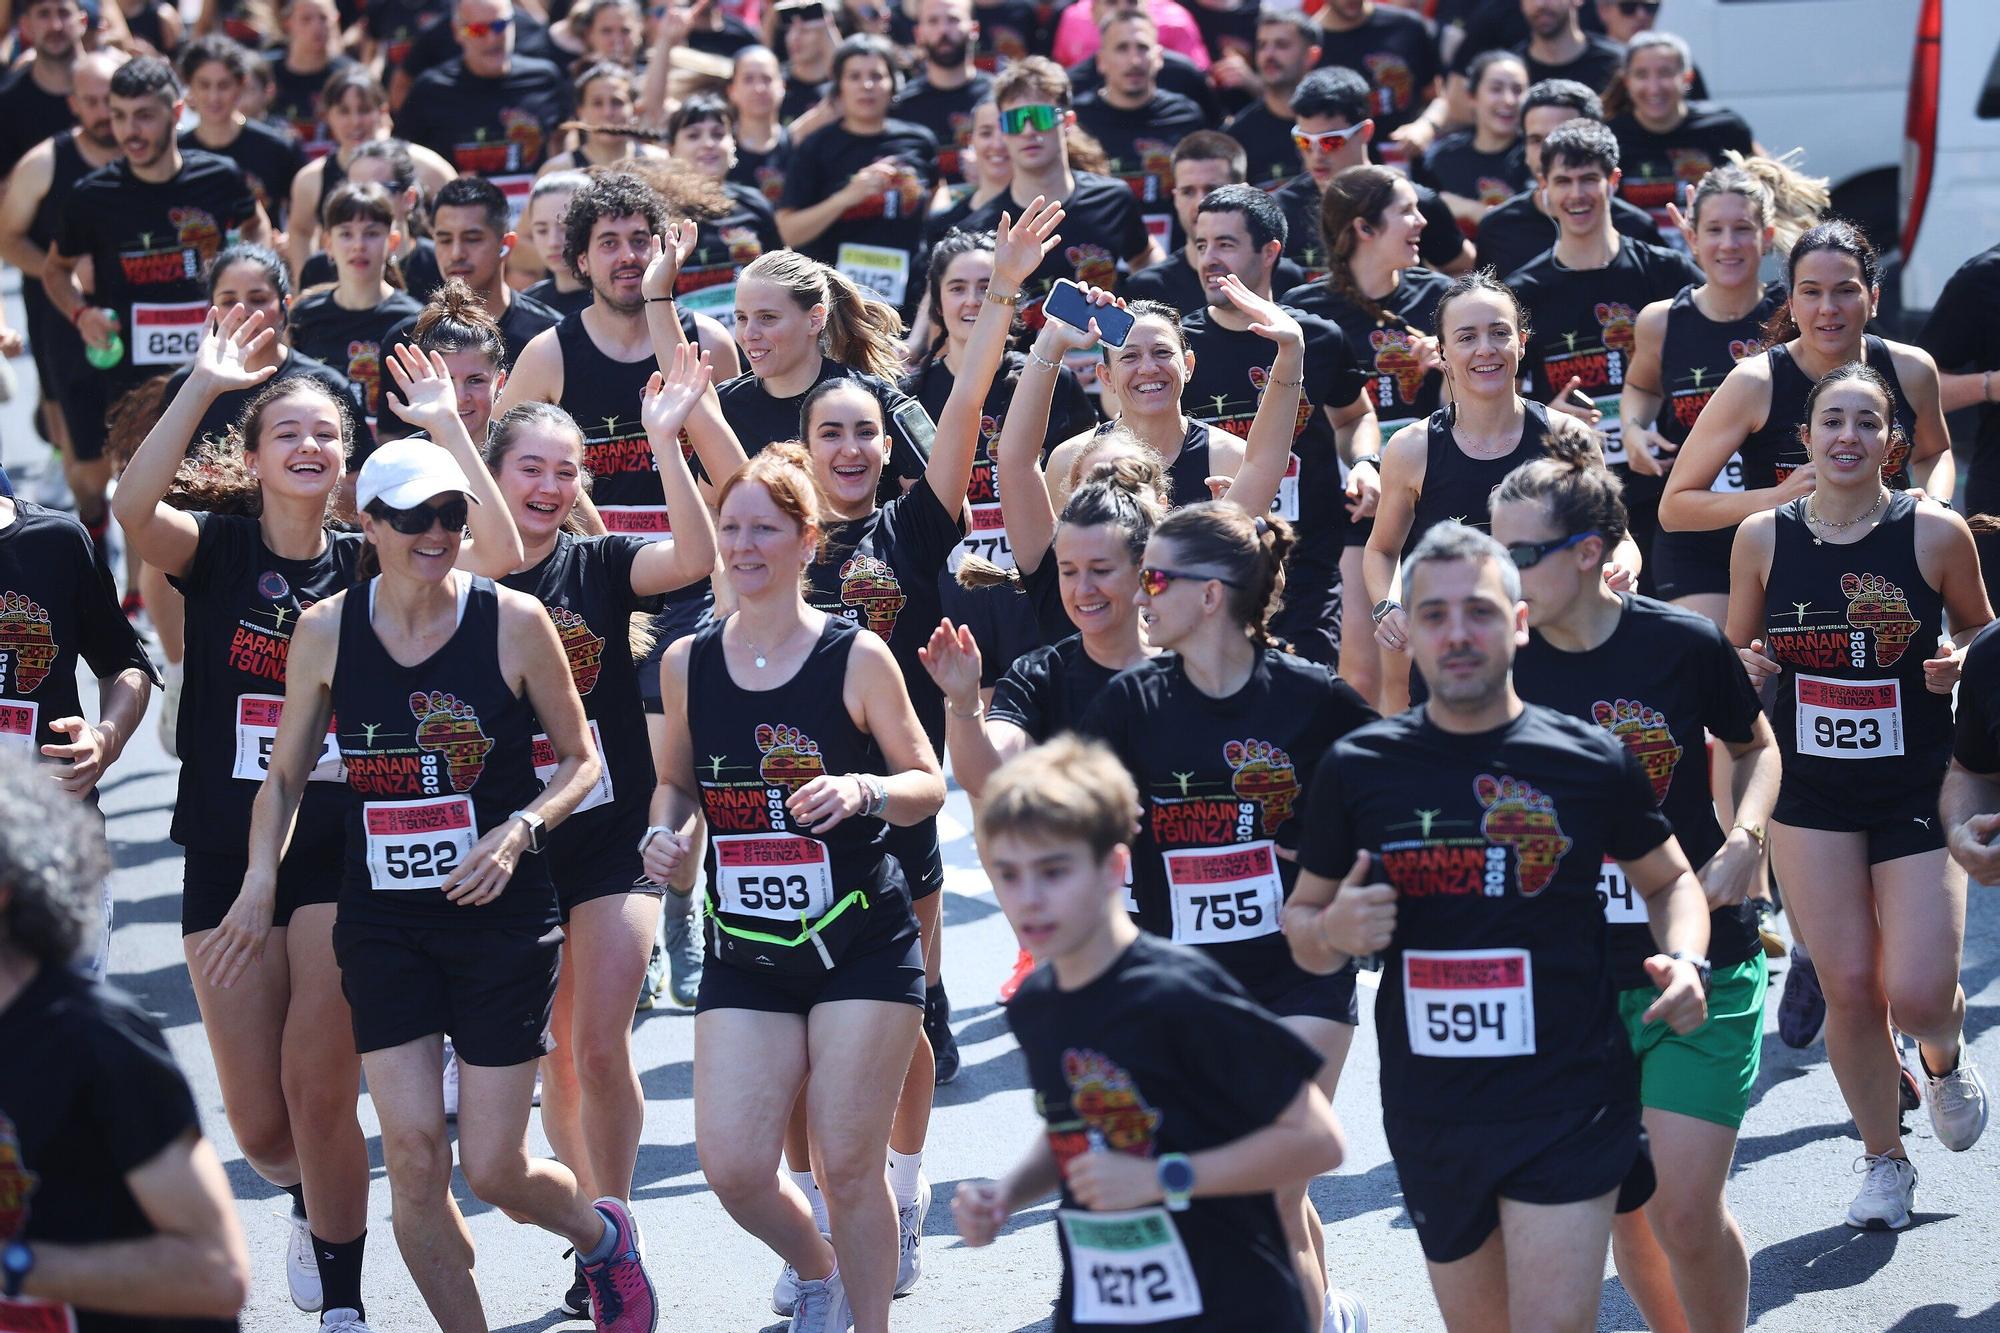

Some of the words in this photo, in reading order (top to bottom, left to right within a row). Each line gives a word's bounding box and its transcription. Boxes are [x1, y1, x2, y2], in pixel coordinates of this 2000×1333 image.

[149, 332, 200, 355] 826
[231, 628, 289, 659] BARAÑ
[1849, 631, 1866, 668] 2026
[1829, 686, 1875, 698] BARAÑAIN
[1830, 697, 1877, 707] TSUNZA
[1814, 715, 1882, 750] 923
[420, 754, 440, 795] 2026
[397, 806, 447, 820] BARAÑAIN
[704, 787, 767, 808] RAÑAIN
[766, 788, 786, 831] 2026
[400, 817, 449, 830] TSUNZA
[1236, 803, 1254, 841] 2026
[385, 840, 458, 879] 522
[753, 840, 801, 851] BARAÑAIN
[754, 849, 802, 862] TSUNZA
[1203, 864, 1253, 880] TSUNZA
[1484, 847, 1507, 897] 2026
[737, 874, 810, 910] 593
[1189, 889, 1263, 931] 755
[1426, 1003, 1507, 1042] 594
[1091, 1262, 1175, 1305] 1272
